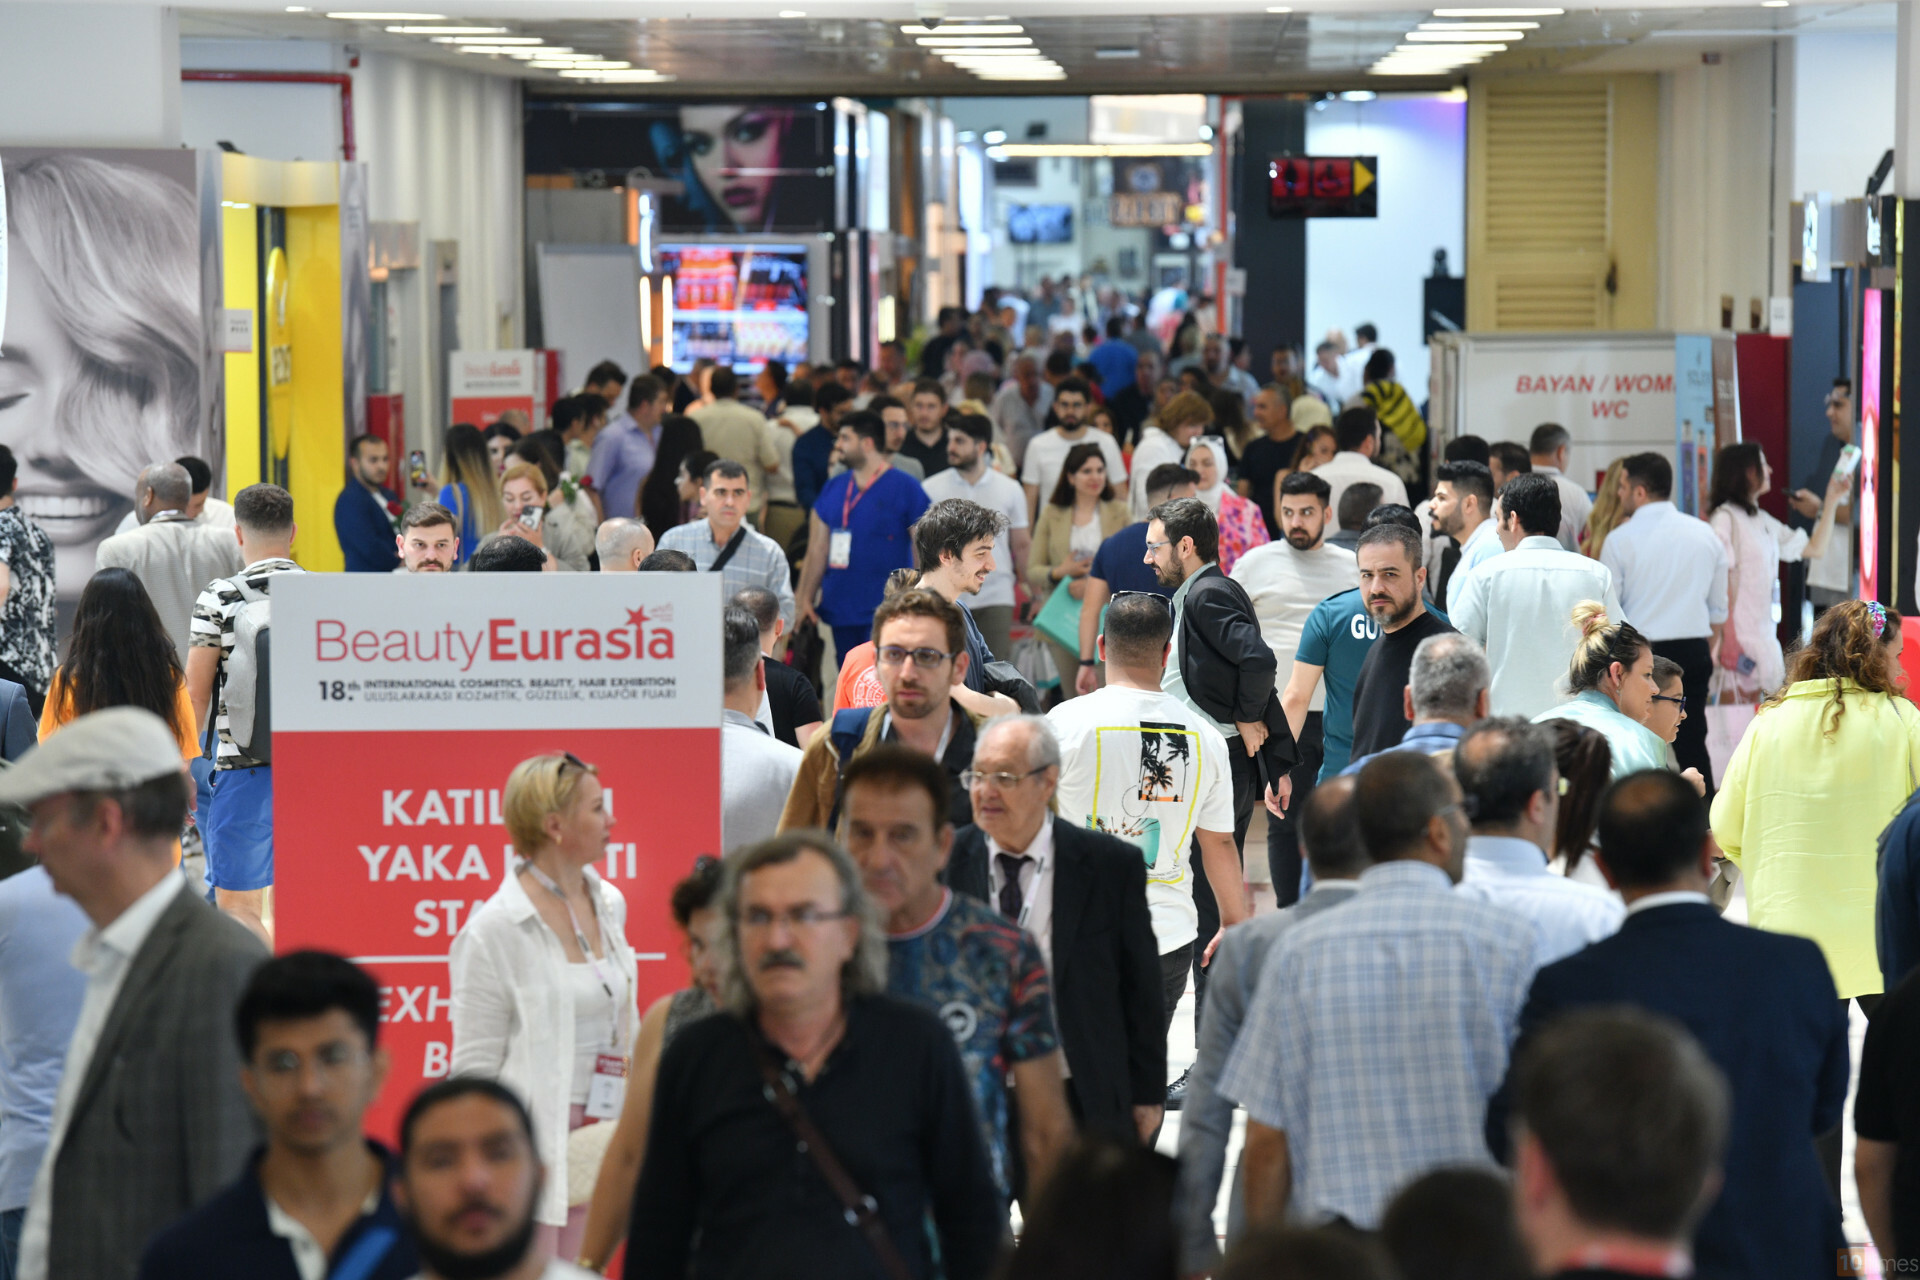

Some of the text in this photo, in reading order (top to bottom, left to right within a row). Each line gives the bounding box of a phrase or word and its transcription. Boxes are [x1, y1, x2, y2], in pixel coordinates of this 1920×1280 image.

[1516, 374, 1595, 394] BAYAN
[1615, 373, 1676, 393] WOM
[1592, 400, 1630, 419] WC
[364, 679, 457, 690] INTERNATIONAL
[578, 677, 607, 688] HAIR
[610, 676, 677, 688] EXHIBITION
[364, 691, 453, 702] ULUSLARARASI
[642, 688, 677, 700] FUARI
[357, 844, 492, 882] YAKA
